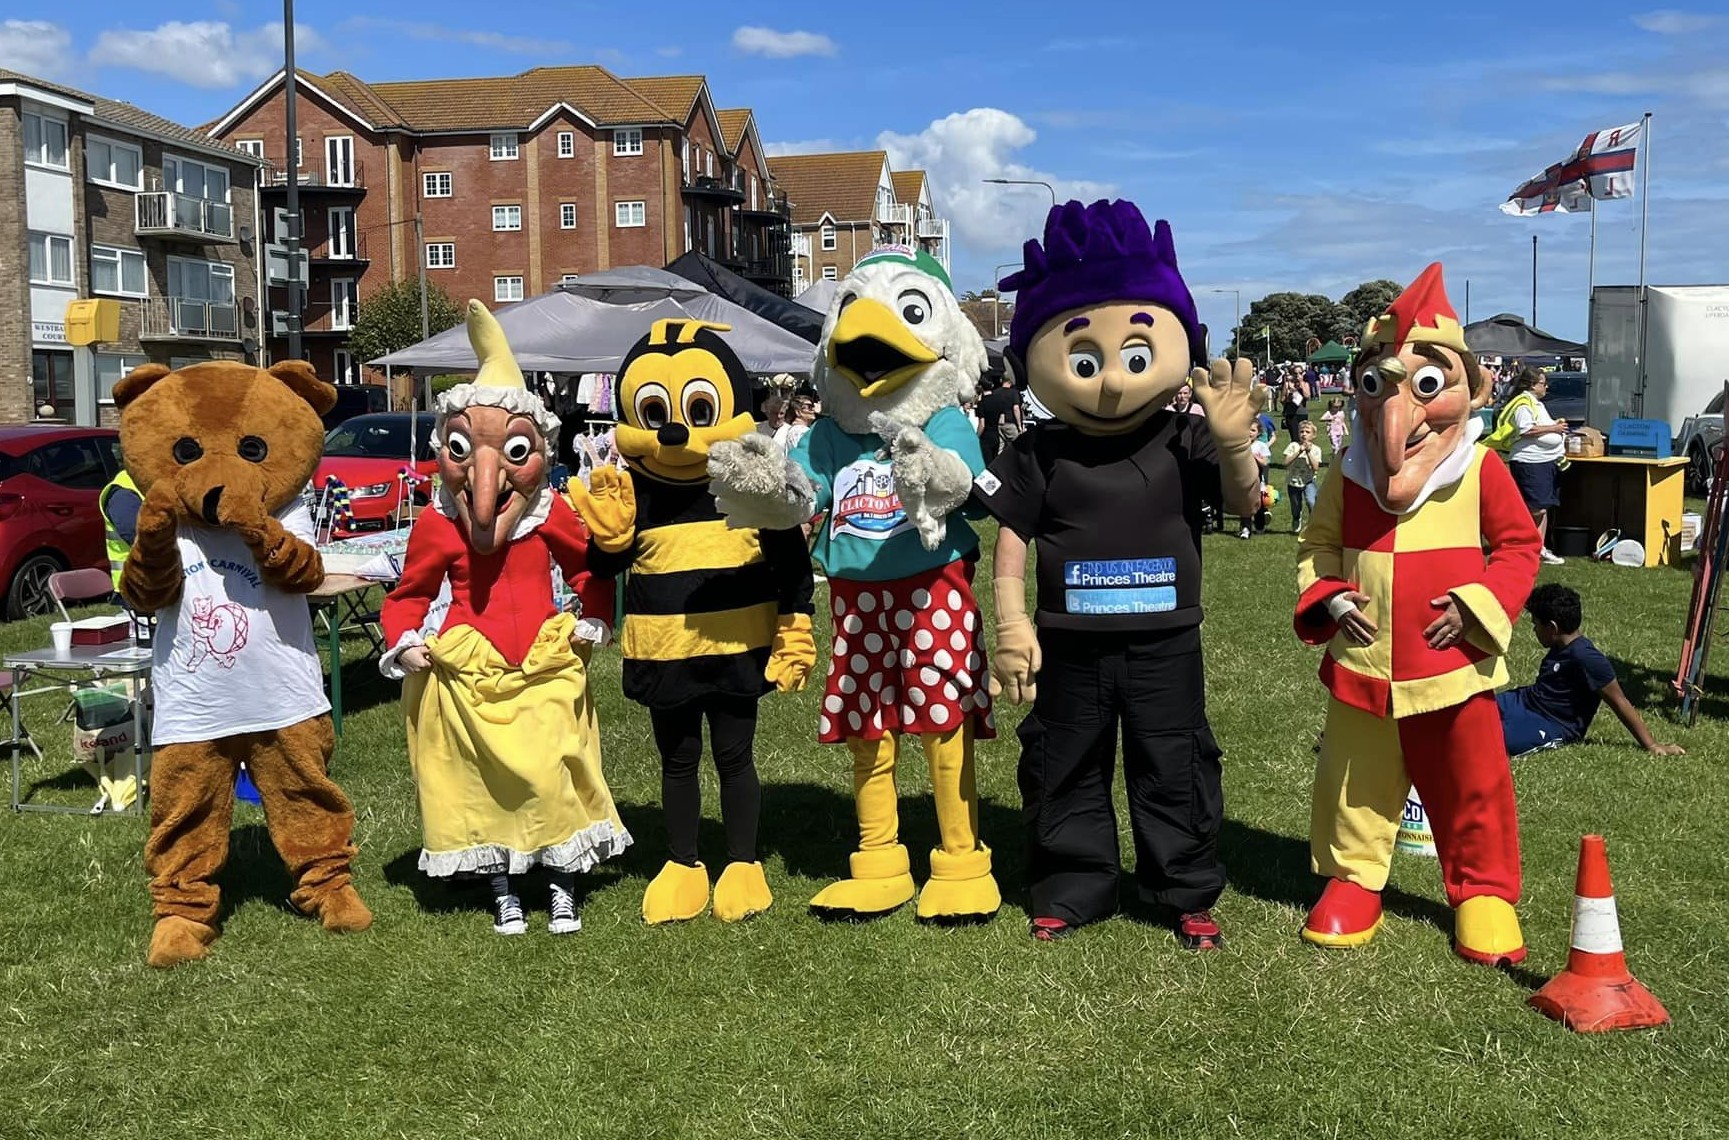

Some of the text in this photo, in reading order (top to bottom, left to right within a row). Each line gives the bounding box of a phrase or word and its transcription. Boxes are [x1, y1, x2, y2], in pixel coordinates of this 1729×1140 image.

[840, 497, 891, 513] CLACTON
[210, 559, 263, 589] CARNIVAL
[1082, 562, 1103, 574] FIND
[1105, 562, 1118, 573] US
[1082, 574, 1131, 586] Princes
[1132, 570, 1176, 584] Theatre
[1082, 602, 1130, 614] Princes
[1131, 600, 1175, 613] Theatre
